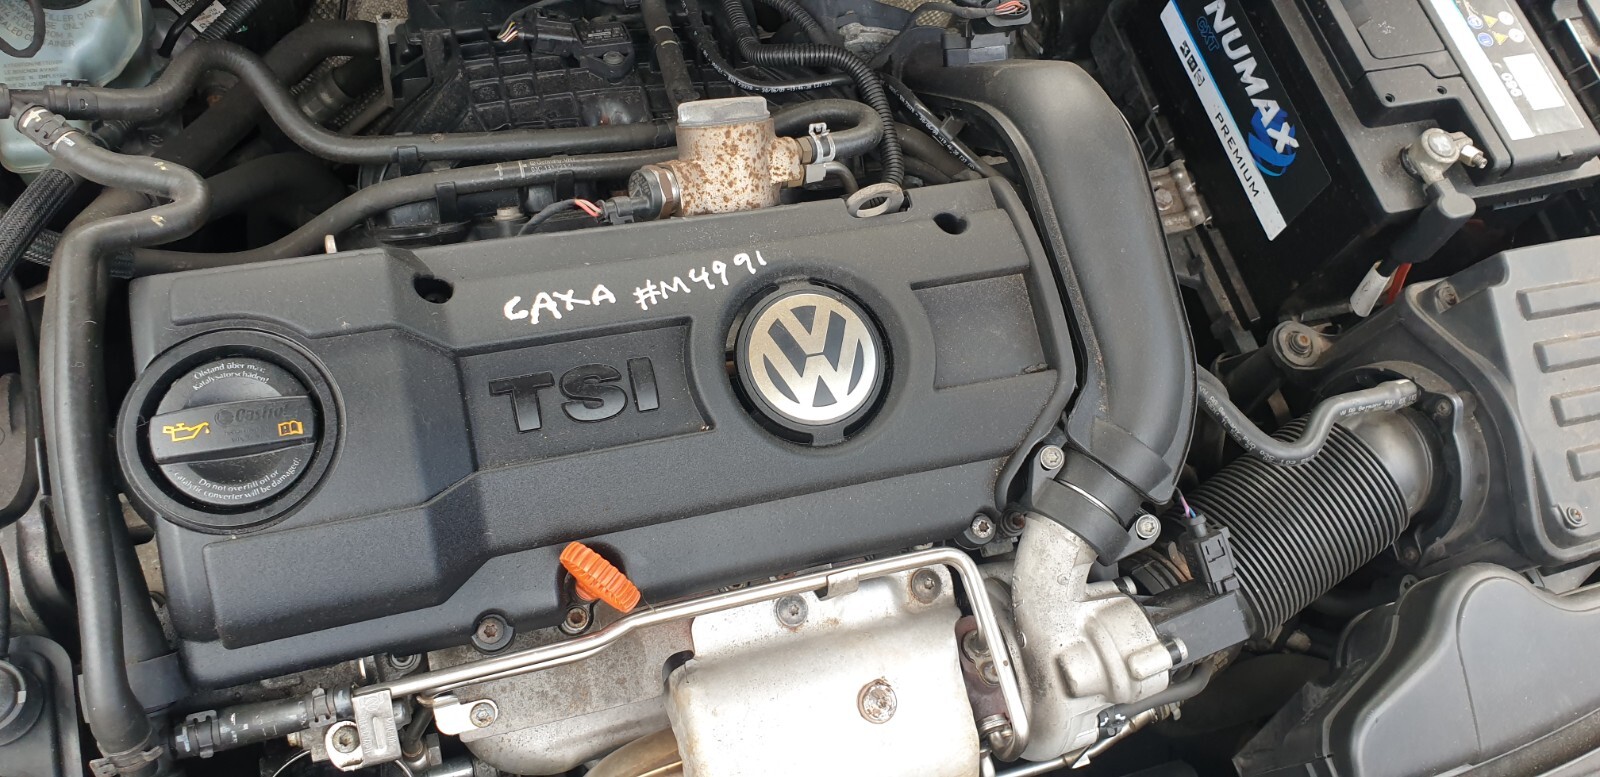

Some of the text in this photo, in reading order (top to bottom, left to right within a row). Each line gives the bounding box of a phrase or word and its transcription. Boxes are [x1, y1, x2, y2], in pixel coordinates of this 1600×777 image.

[1203, 0, 1299, 154] NUMAX
[1215, 112, 1260, 197] PREMIUM
[504, 284, 616, 324] CAXA
[489, 356, 660, 433] TSI
[199, 478, 211, 487] Do
[211, 483, 228, 492] not
[228, 478, 259, 492] overfill
[203, 489, 243, 500] converter
[243, 487, 260, 498] will
[260, 484, 272, 493] be
